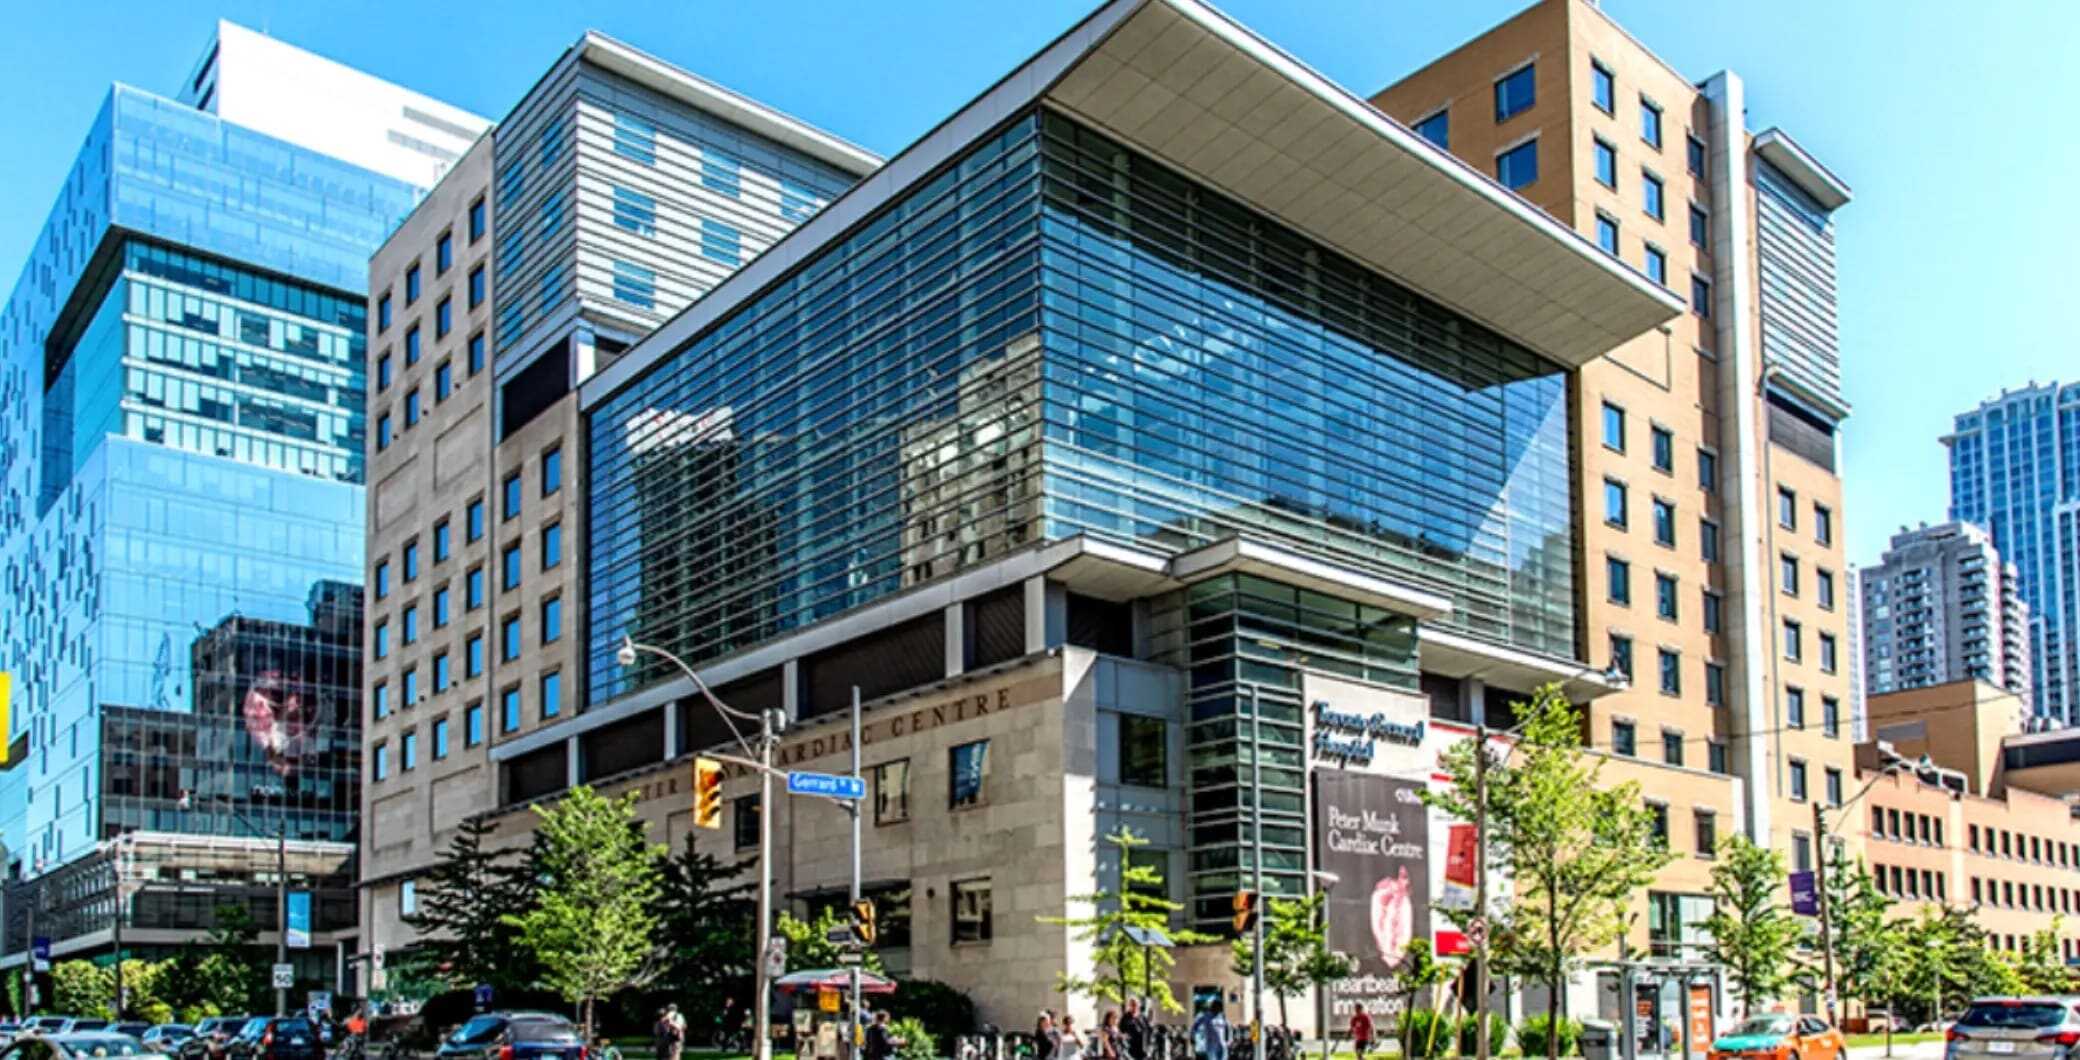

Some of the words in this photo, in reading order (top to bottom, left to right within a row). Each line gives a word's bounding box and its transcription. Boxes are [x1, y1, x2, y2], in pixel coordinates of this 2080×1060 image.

[778, 724, 874, 767] ARDIAC
[891, 688, 1011, 738] CENTRE
[1328, 805, 1361, 830] Peter
[1362, 809, 1400, 835] Munk
[1327, 829, 1379, 856] Cardiac
[1380, 833, 1423, 860] Centre
